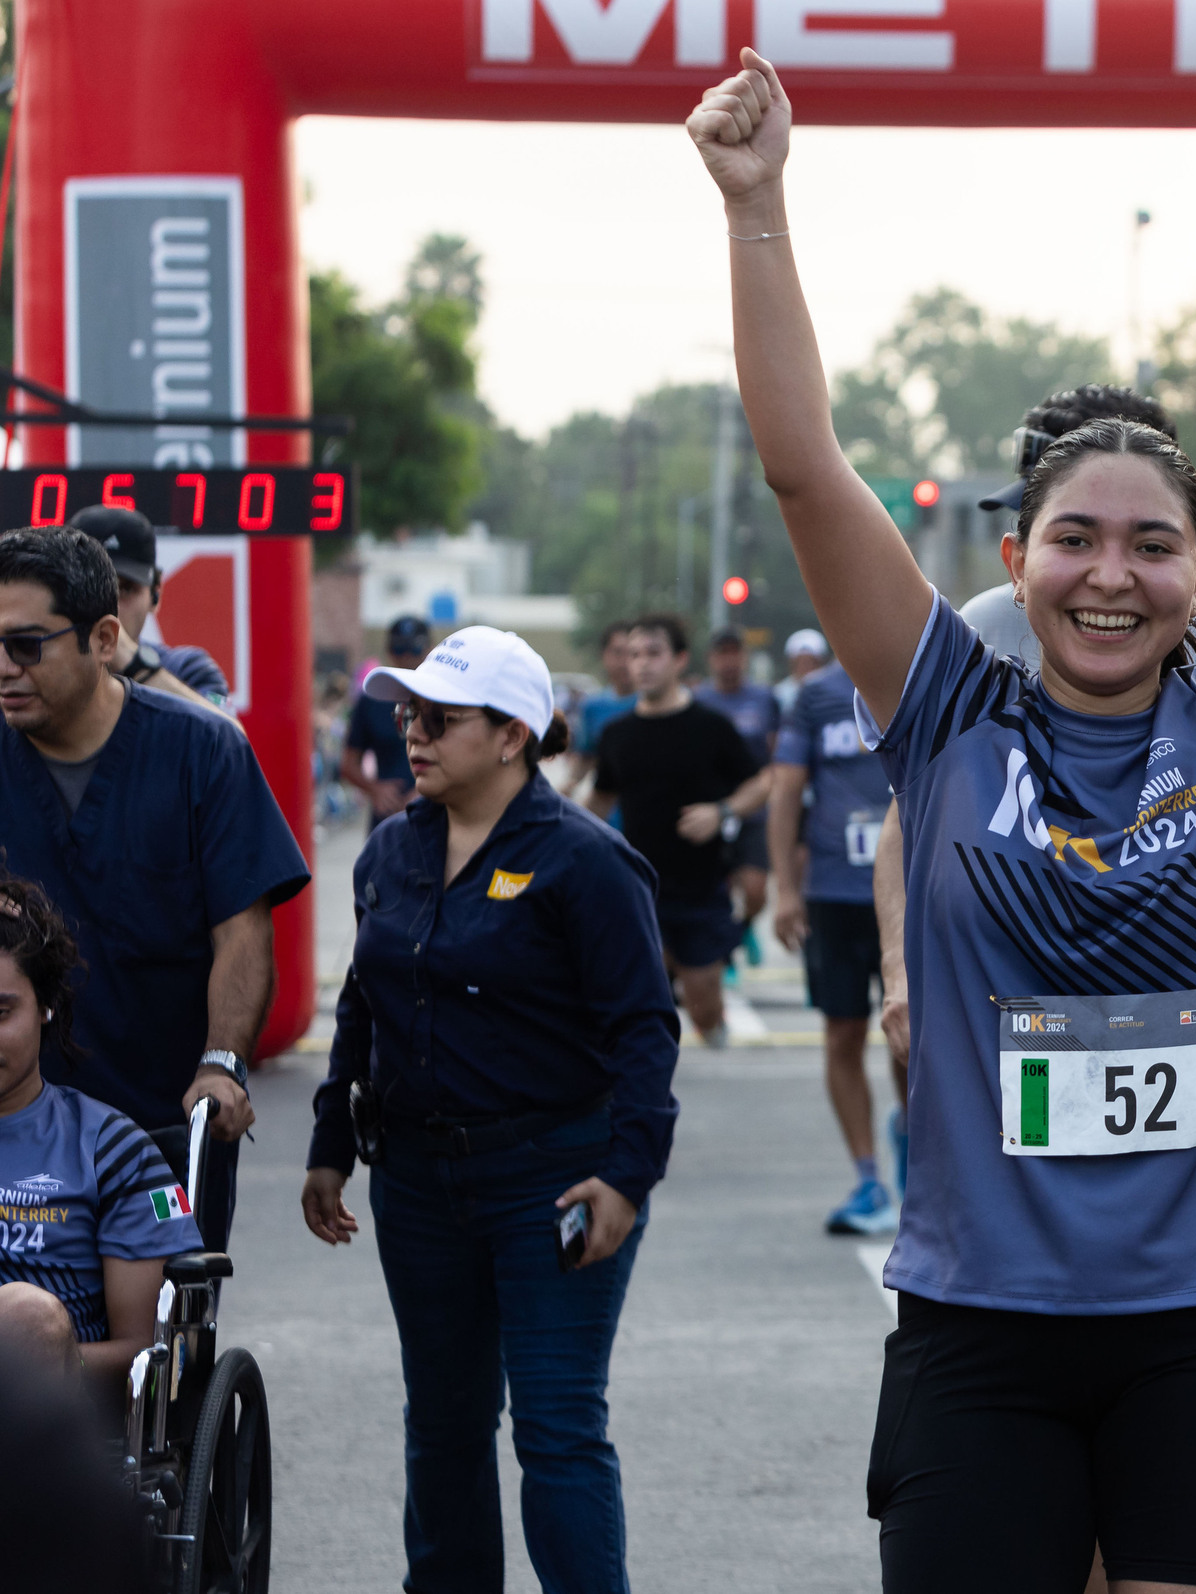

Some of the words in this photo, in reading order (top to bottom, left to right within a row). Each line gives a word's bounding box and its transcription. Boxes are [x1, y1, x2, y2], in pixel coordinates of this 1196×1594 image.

[130, 217, 212, 469] ernium
[1146, 741, 1176, 770] etica
[1137, 766, 1185, 812] NIUM
[1012, 1013, 1046, 1033] 10K
[1046, 1022, 1066, 1032] 2024
[1108, 1015, 1134, 1023] CORRER
[1118, 1021, 1145, 1029] ACTITUD
[1021, 1063, 1048, 1077] 10K
[1104, 1062, 1178, 1136] 52
[0, 1204, 69, 1223] NTERREY
